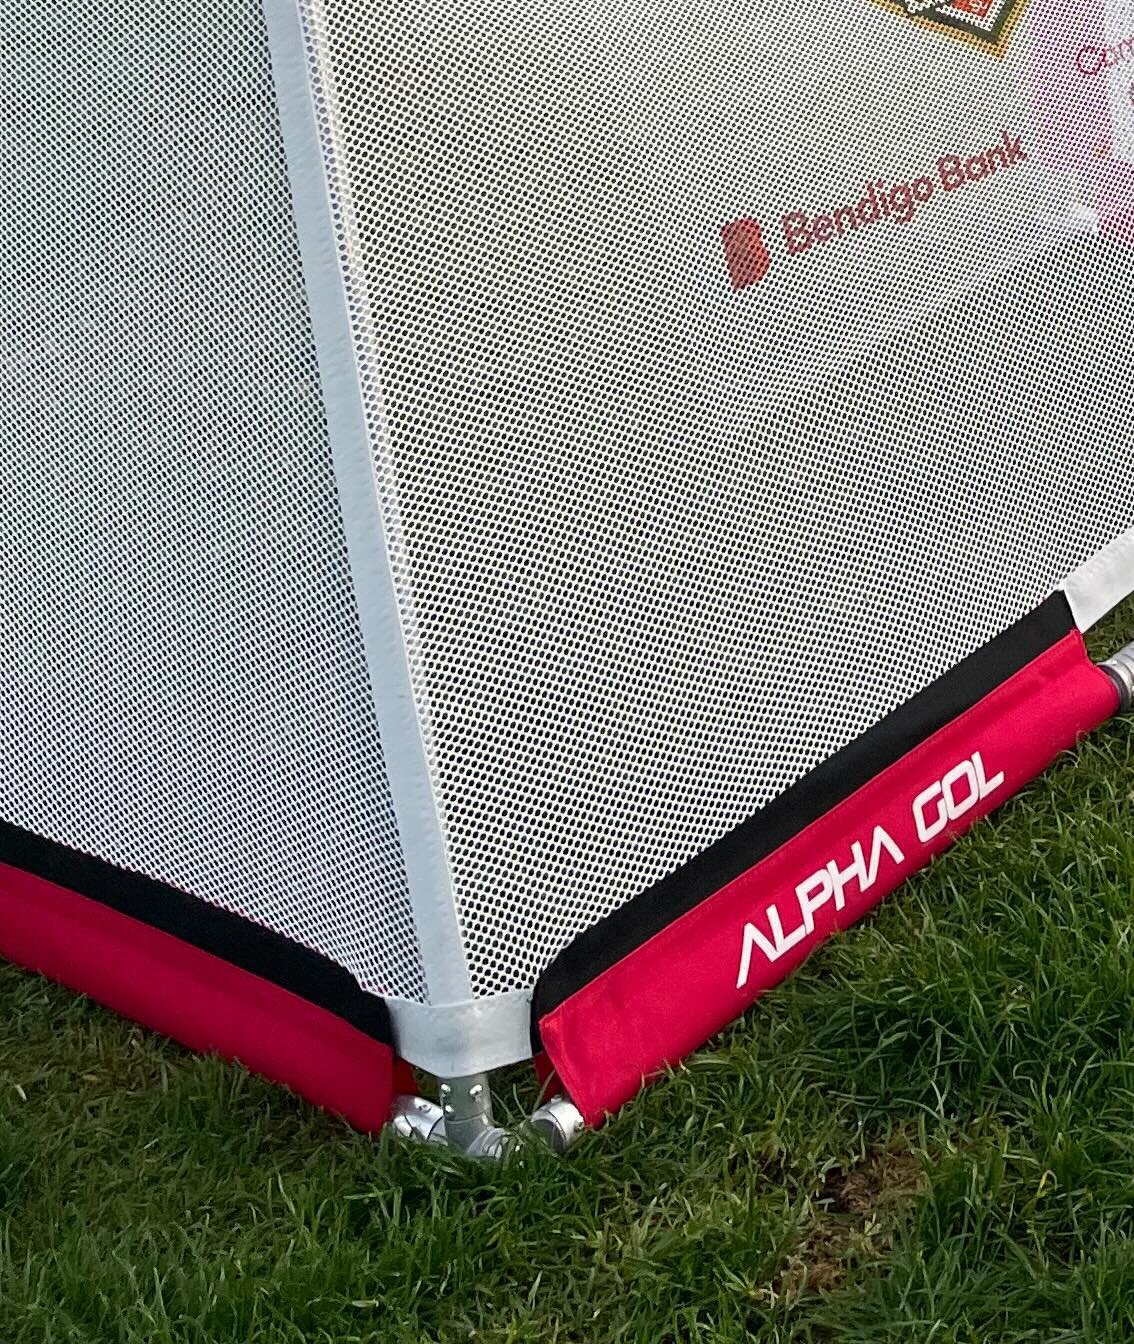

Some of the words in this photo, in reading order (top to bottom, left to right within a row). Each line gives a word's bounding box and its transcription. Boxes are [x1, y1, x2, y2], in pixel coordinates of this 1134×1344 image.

[782, 175, 934, 256] Bendigo
[937, 129, 1028, 193] Bank
[736, 824, 905, 990] ALPHA
[912, 751, 1005, 843] GOL
